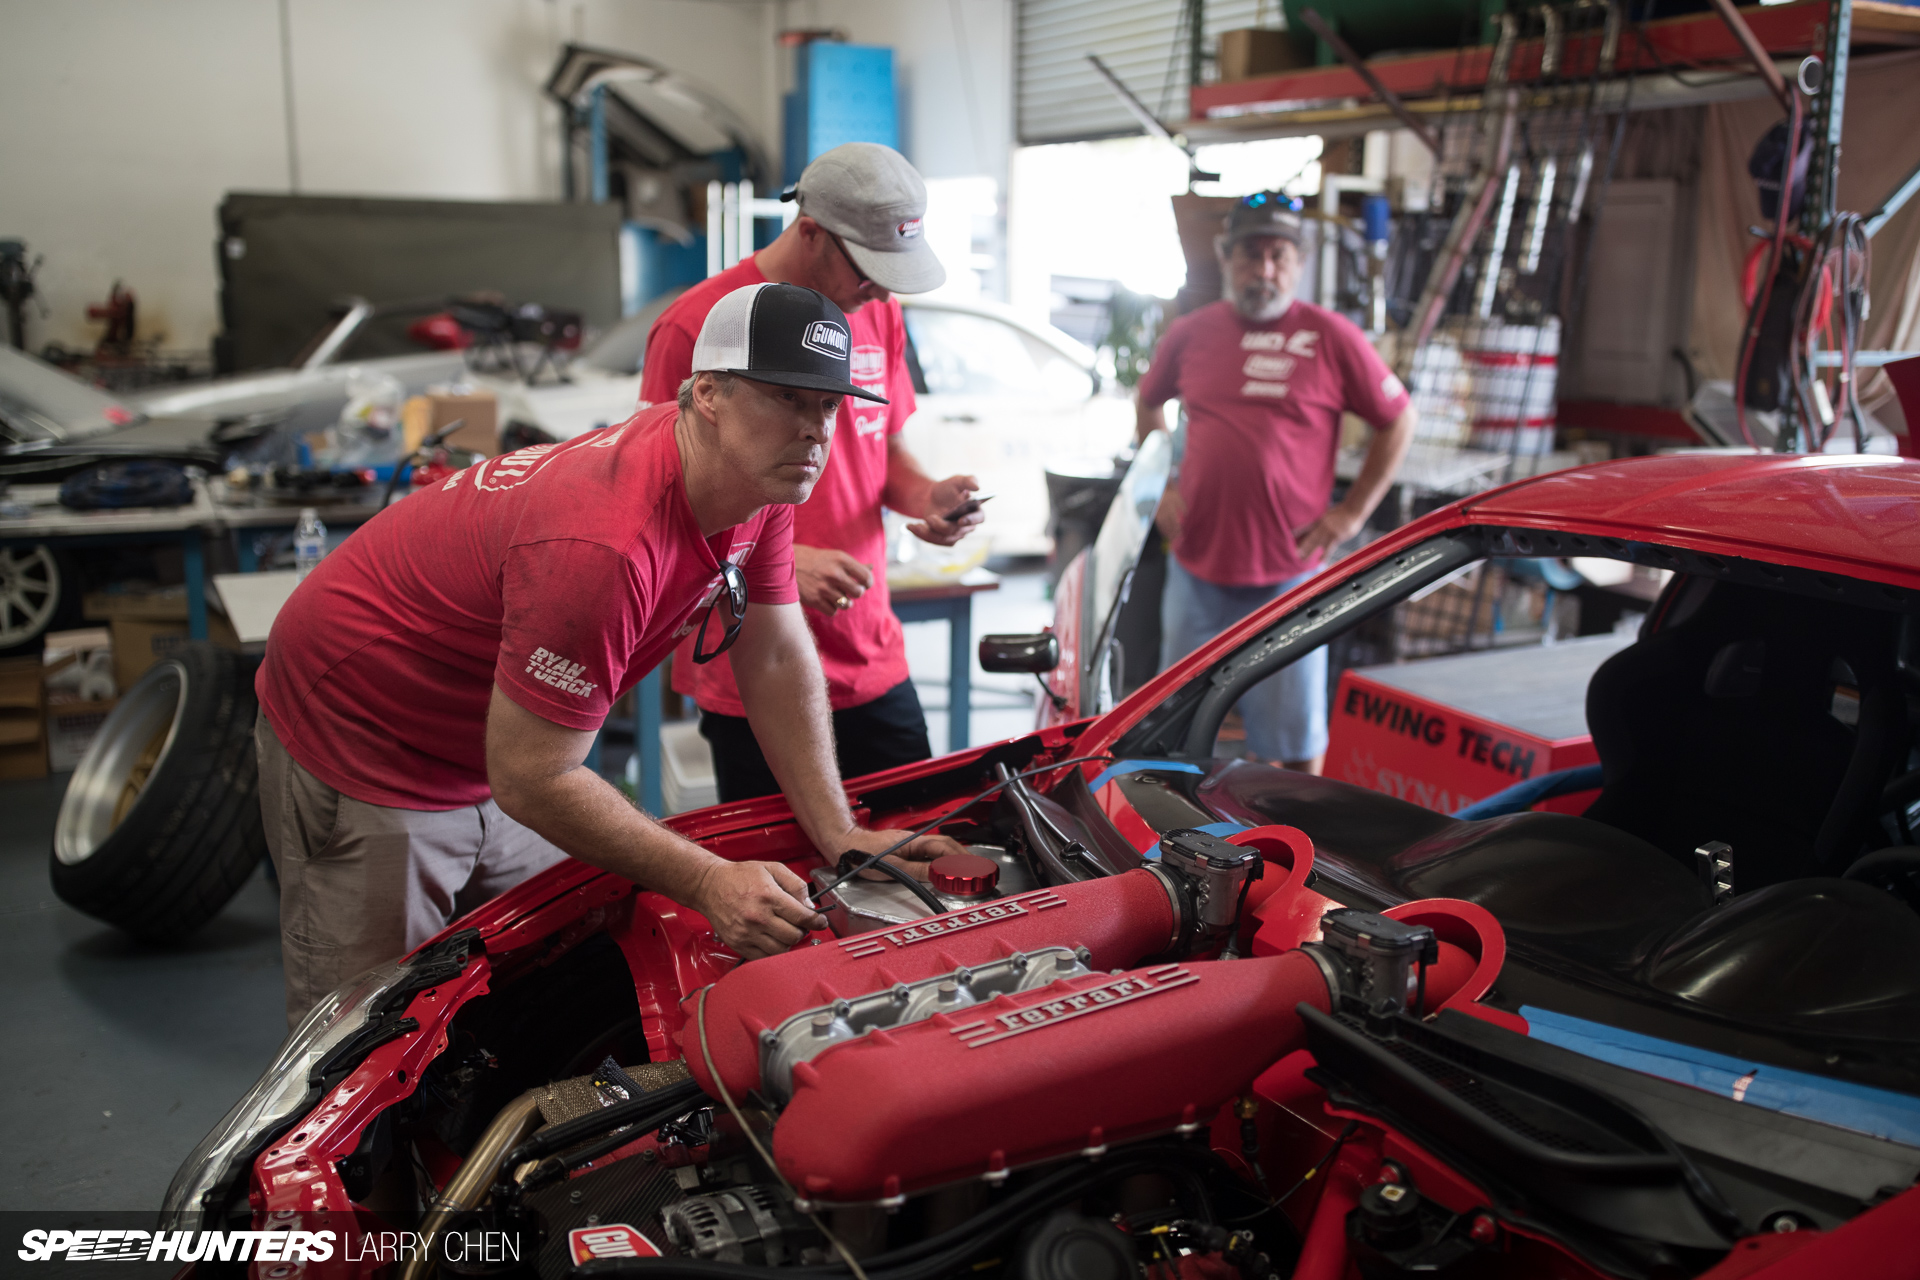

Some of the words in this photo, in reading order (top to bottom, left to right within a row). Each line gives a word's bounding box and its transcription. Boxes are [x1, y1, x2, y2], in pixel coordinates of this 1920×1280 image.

[812, 324, 846, 351] GUMOUT
[525, 659, 598, 698] TUERCK
[530, 647, 586, 678] RYAN
[1345, 689, 1445, 745] EWING
[1458, 727, 1535, 779] TECH
[884, 902, 1028, 946] Ferrari
[996, 976, 1153, 1030] Ferrari
